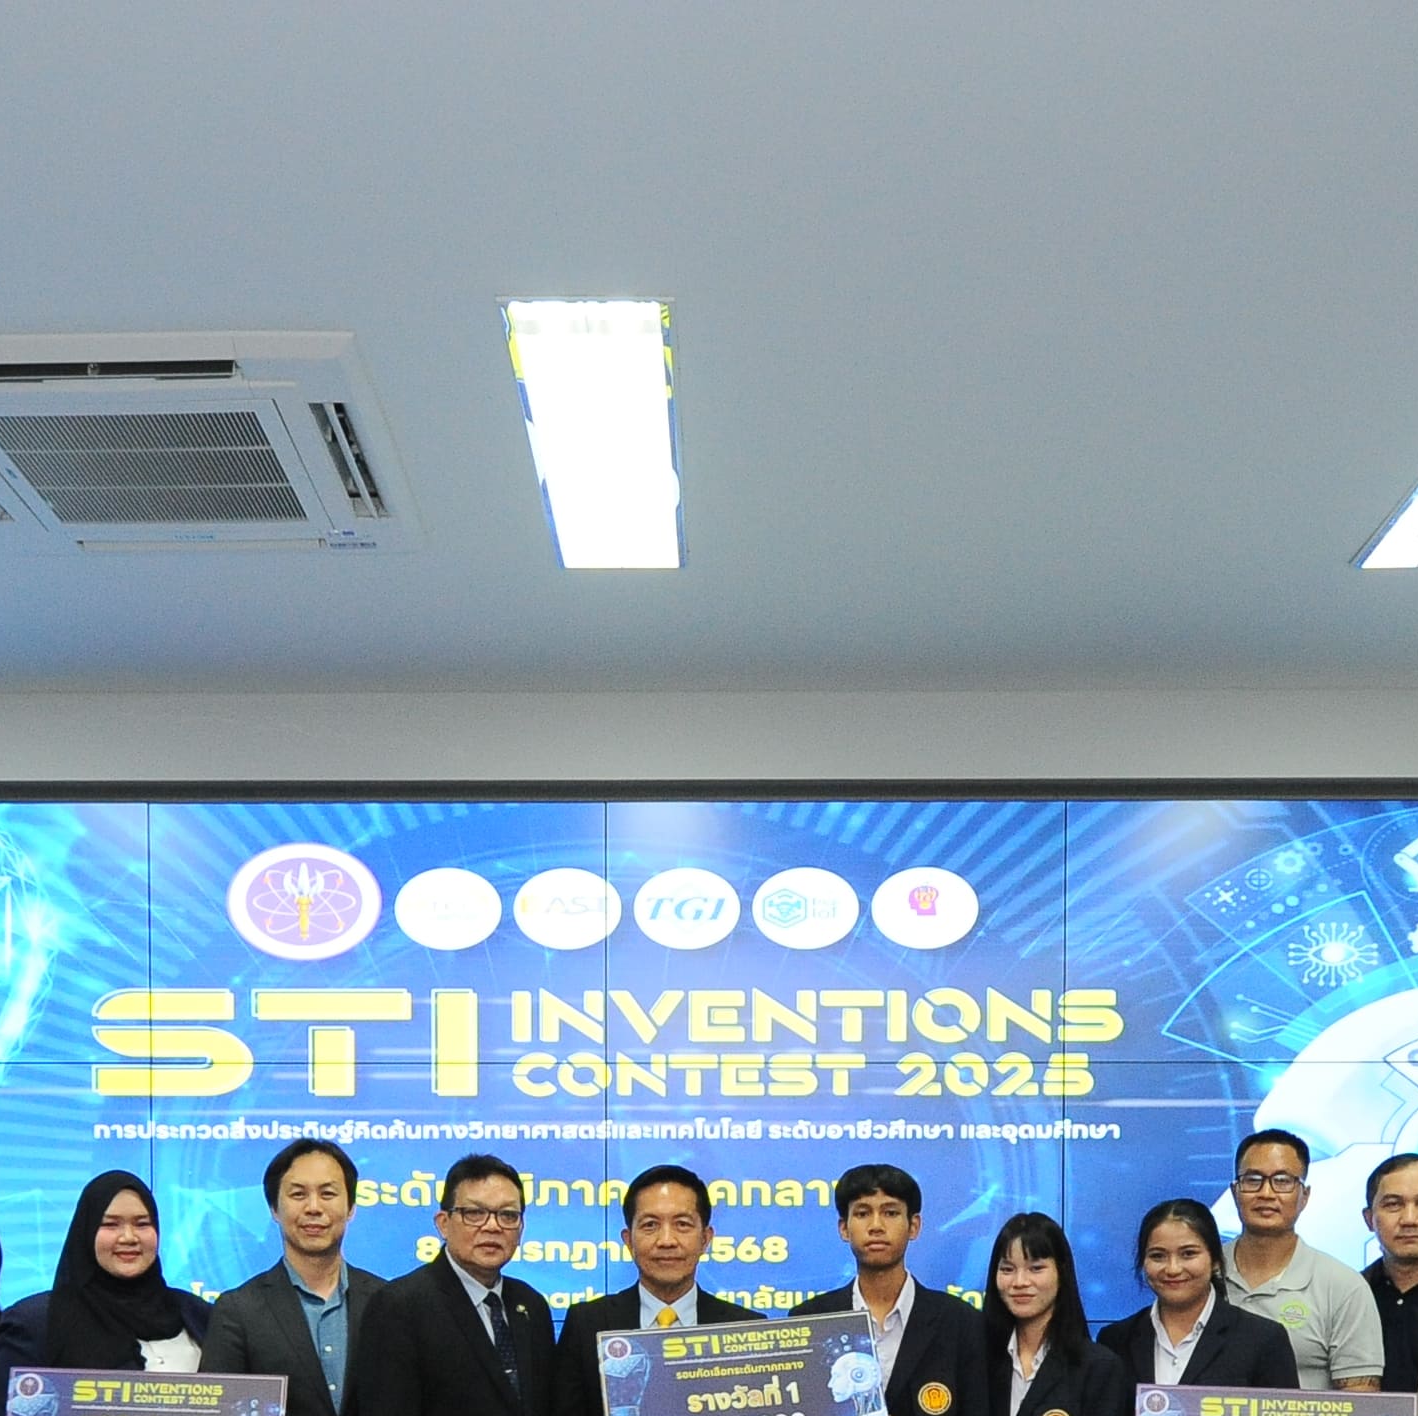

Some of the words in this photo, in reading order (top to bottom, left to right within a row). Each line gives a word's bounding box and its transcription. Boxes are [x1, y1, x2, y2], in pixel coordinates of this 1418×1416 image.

[647, 897, 725, 920] TGI
[512, 987, 1125, 1044] INVENTIONS
[92, 988, 479, 1097] STI
[512, 1052, 867, 1097] CONTEST
[894, 1052, 1096, 1097] 2025
[768, 1117, 954, 1140] ระดับอาชีวศึกษา
[662, 1335, 719, 1358] STI
[723, 1327, 811, 1344] INVENTIONS
[724, 1341, 774, 1354] CONTEST
[73, 1381, 130, 1402] STI
[133, 1394, 186, 1405] CONTEST
[134, 1382, 223, 1395] INVENTIONS
[785, 1381, 800, 1404] 1
[1261, 1400, 1353, 1413] INVENTIONS
